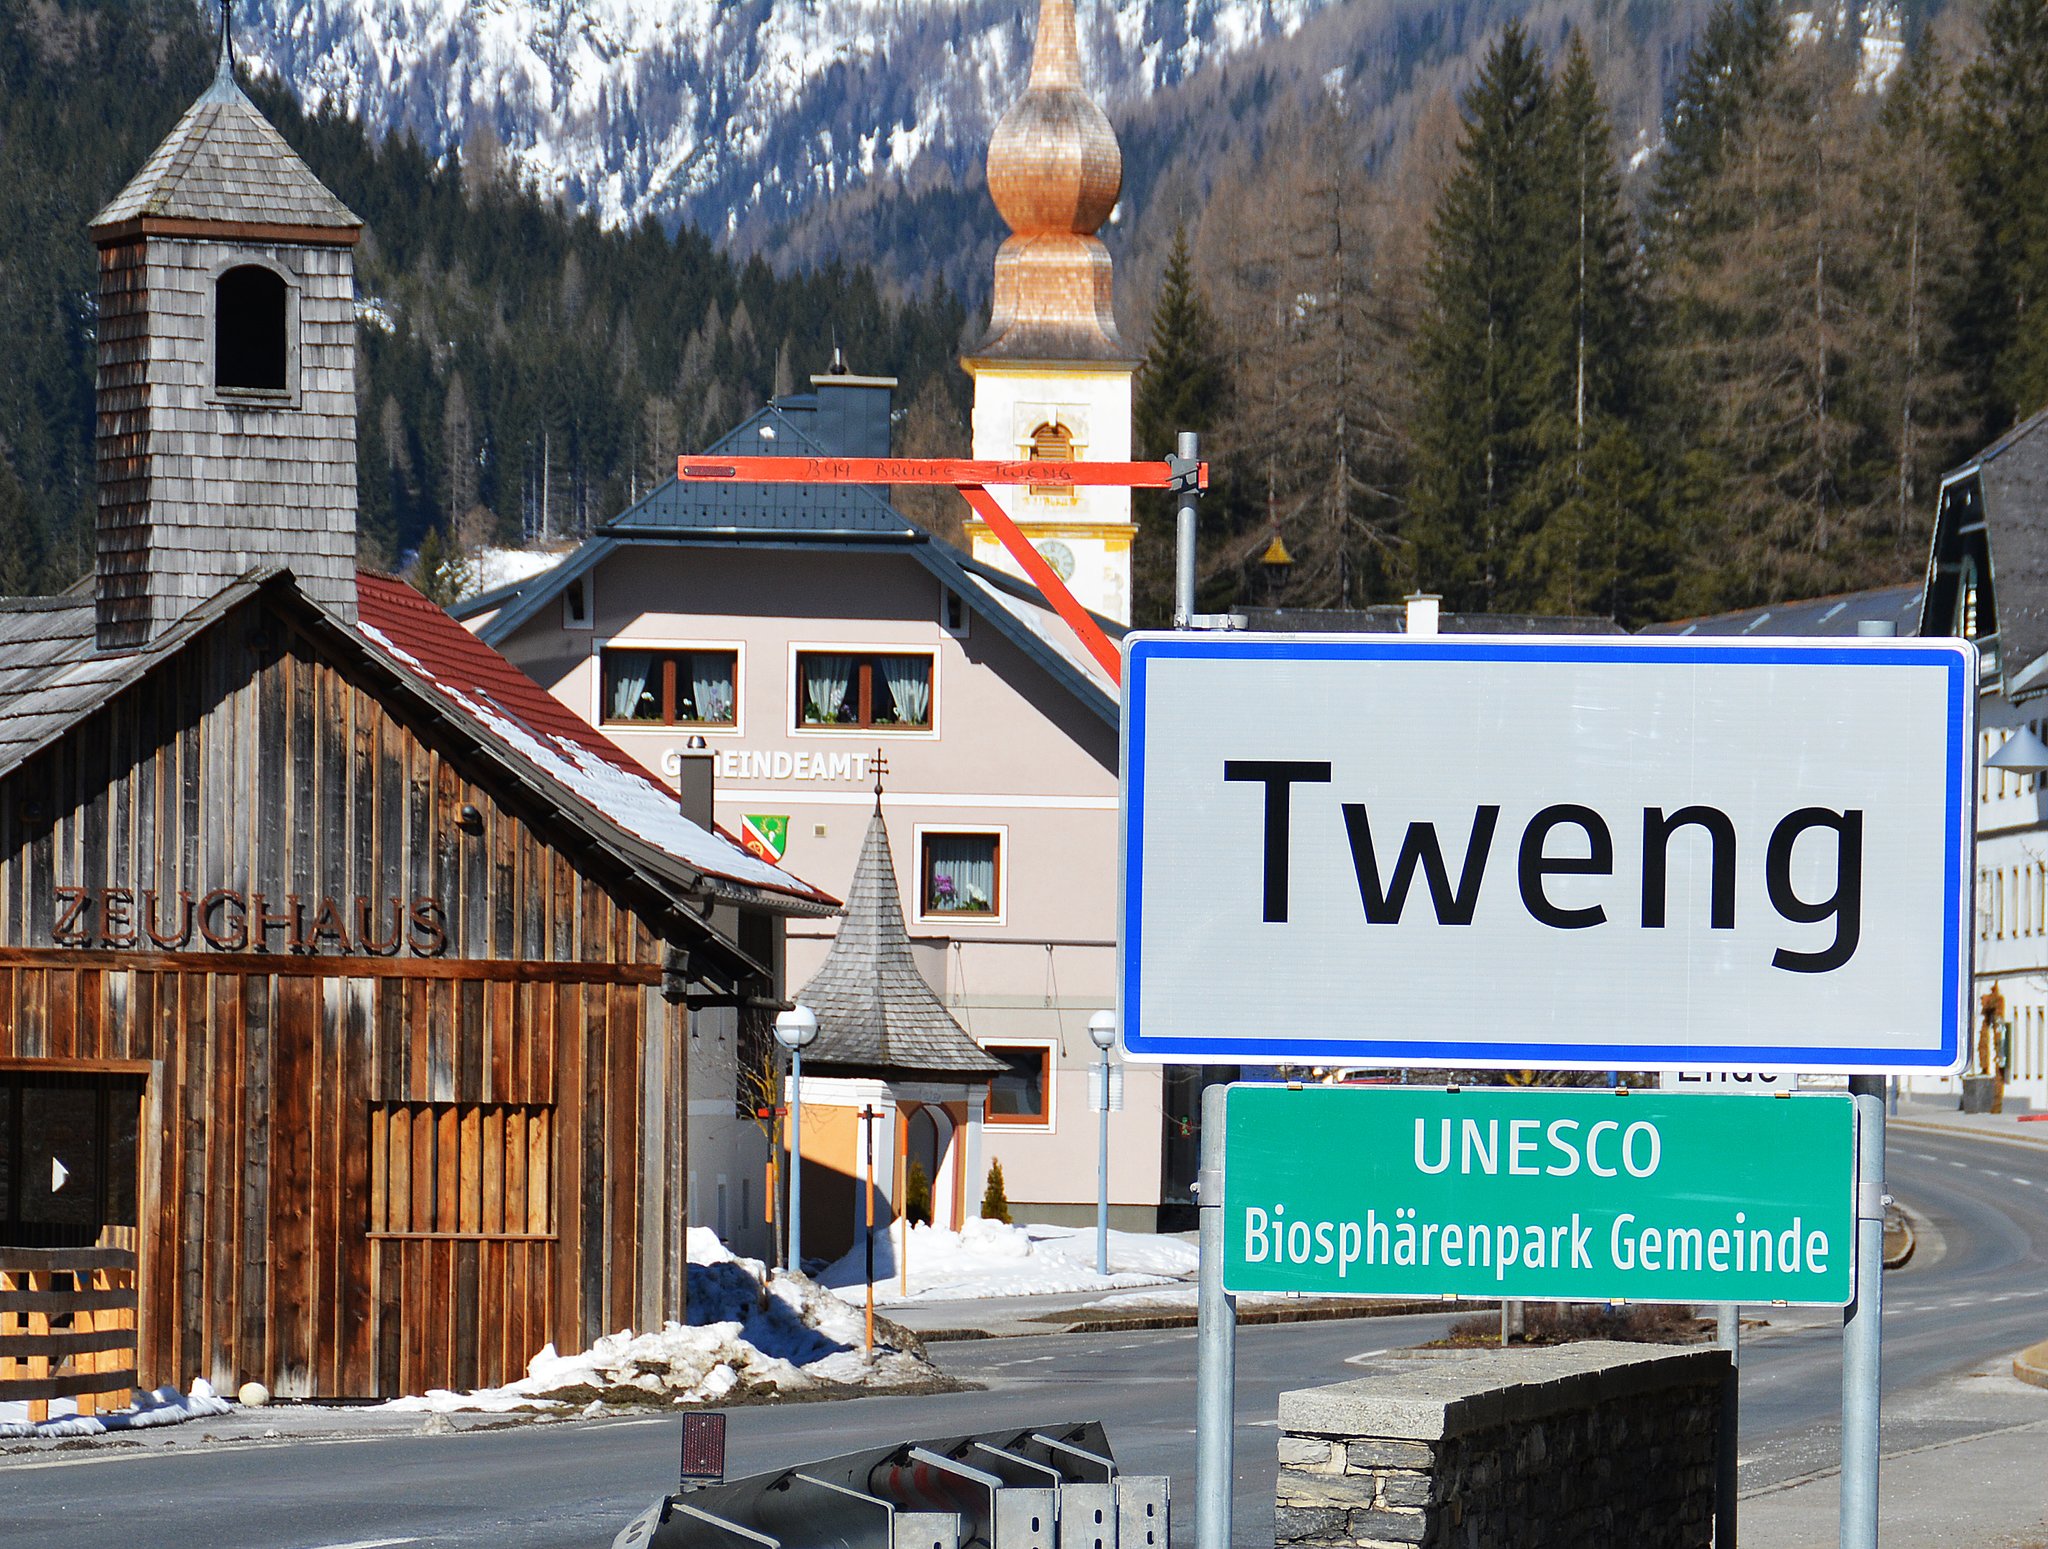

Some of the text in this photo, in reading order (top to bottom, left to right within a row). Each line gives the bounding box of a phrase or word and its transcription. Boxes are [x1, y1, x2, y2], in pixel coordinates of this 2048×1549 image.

[661, 749, 869, 781] GEINDEAMT
[1224, 760, 1863, 973] Tweng
[52, 886, 445, 955] ZEUGHAUS
[1413, 1118, 1662, 1178] UNESCO
[1244, 1204, 1830, 1280] Biosphärenpark Gemeinde
